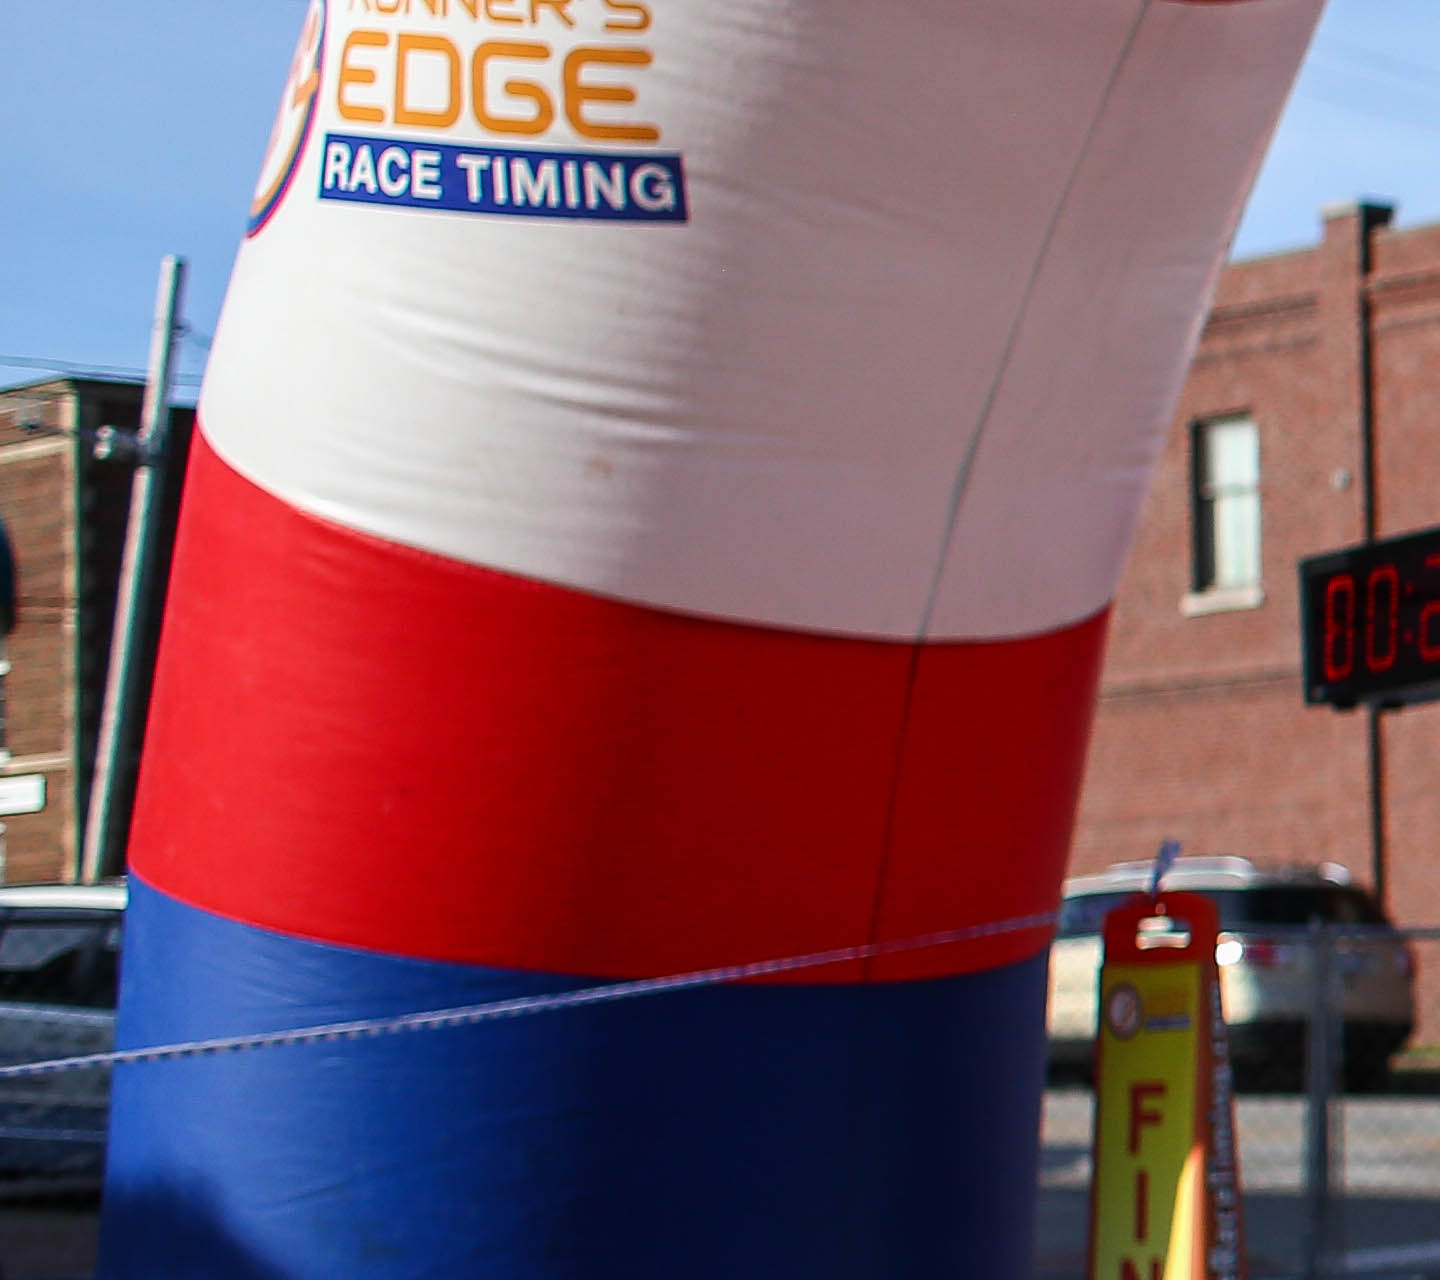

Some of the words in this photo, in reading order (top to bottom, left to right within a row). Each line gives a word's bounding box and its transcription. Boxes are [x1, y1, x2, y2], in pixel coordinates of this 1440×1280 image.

[337, 29, 661, 141] EDGE
[324, 141, 443, 200] RACE
[456, 151, 677, 212] TIMING
